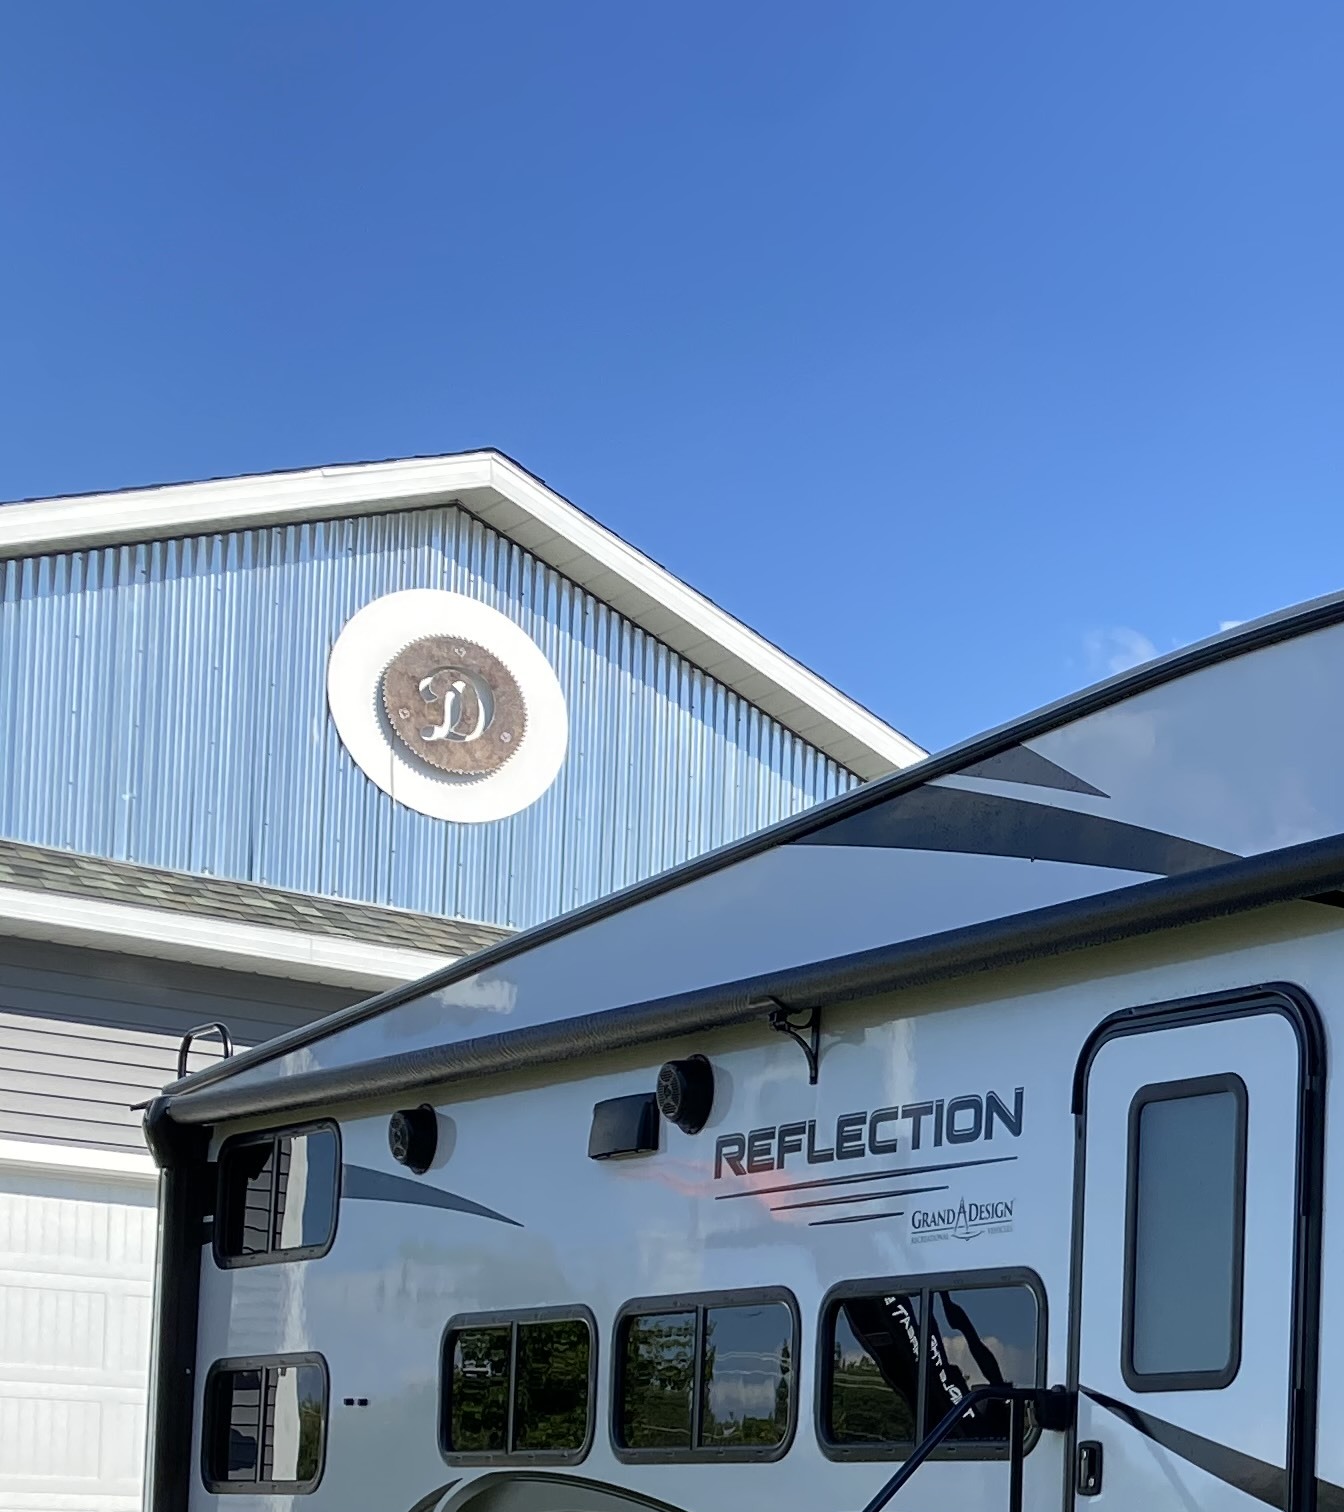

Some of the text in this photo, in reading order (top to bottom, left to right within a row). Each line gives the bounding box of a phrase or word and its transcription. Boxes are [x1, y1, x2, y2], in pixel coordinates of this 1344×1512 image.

[714, 1086, 1025, 1180] REFLECTION
[911, 1199, 1015, 1230] GRAND DESIGN
